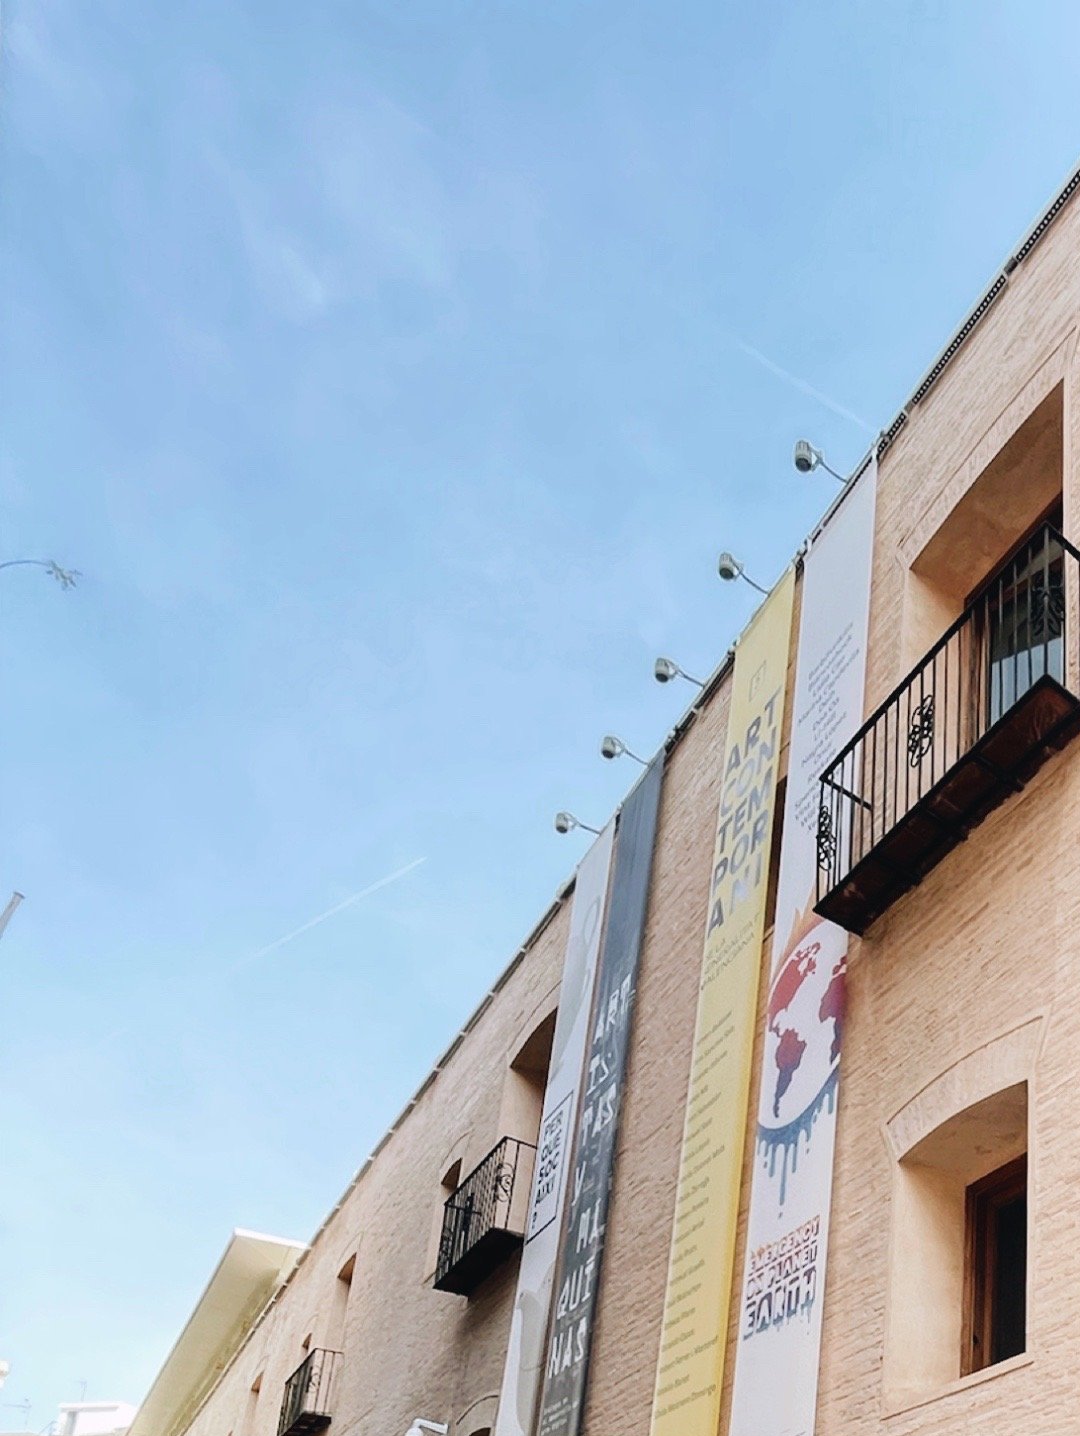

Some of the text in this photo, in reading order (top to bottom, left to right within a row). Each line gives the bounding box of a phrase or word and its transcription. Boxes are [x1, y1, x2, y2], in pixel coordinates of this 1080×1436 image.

[725, 685, 781, 782] ART
[711, 808, 769, 897] POR
[718, 765, 773, 854] TEM
[548, 1316, 588, 1379] NAS
